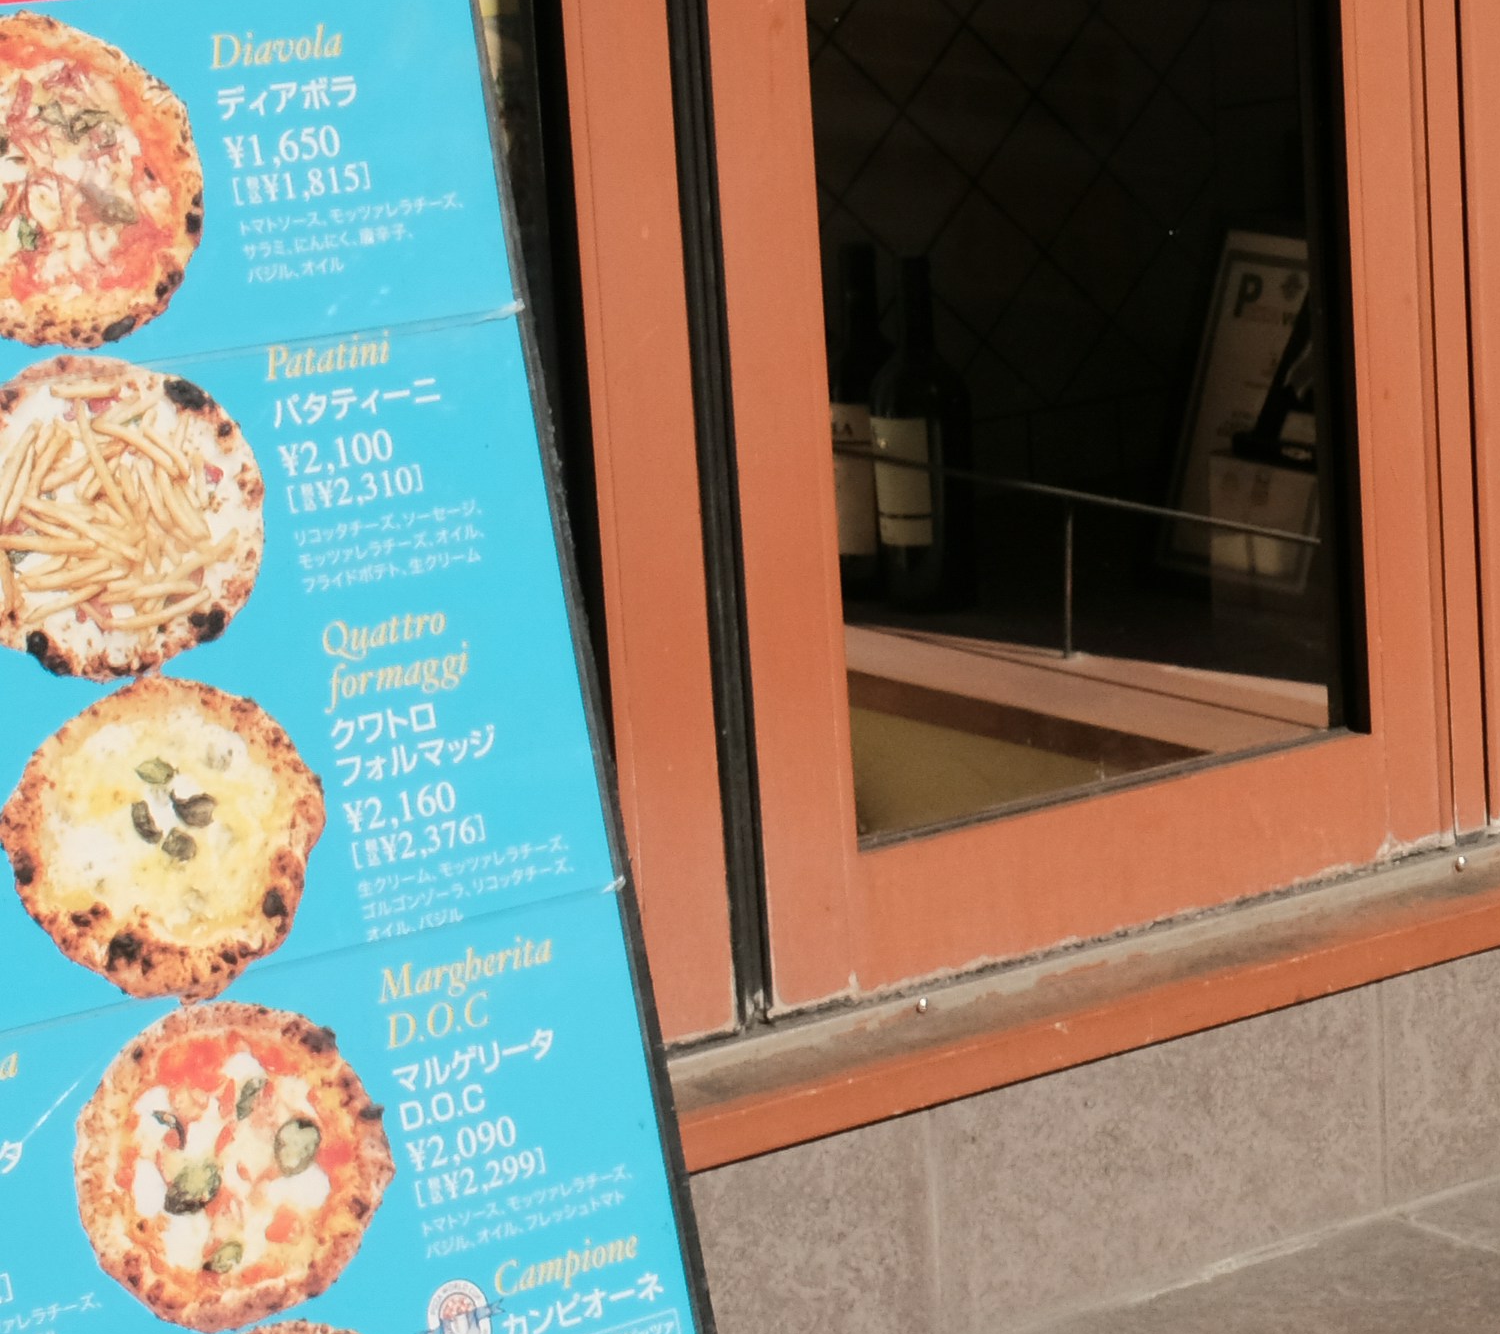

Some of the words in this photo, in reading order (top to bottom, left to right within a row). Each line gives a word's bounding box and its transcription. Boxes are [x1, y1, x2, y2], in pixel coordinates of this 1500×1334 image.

[211, 22, 344, 69] Diavola
[222, 124, 342, 169] ¥1,650
[266, 330, 392, 382] Patatini
[278, 428, 394, 477] ¥2,100
[322, 611, 446, 661] Quattro
[324, 640, 469, 714] formaggi
[331, 702, 437, 751] クワトロ
[343, 781, 456, 834] ¥2,160
[378, 936, 553, 1004] Margherita
[387, 990, 490, 1051] D.O.C
[406, 1115, 517, 1172] ¥2,090
[494, 1234, 640, 1297] Campione
